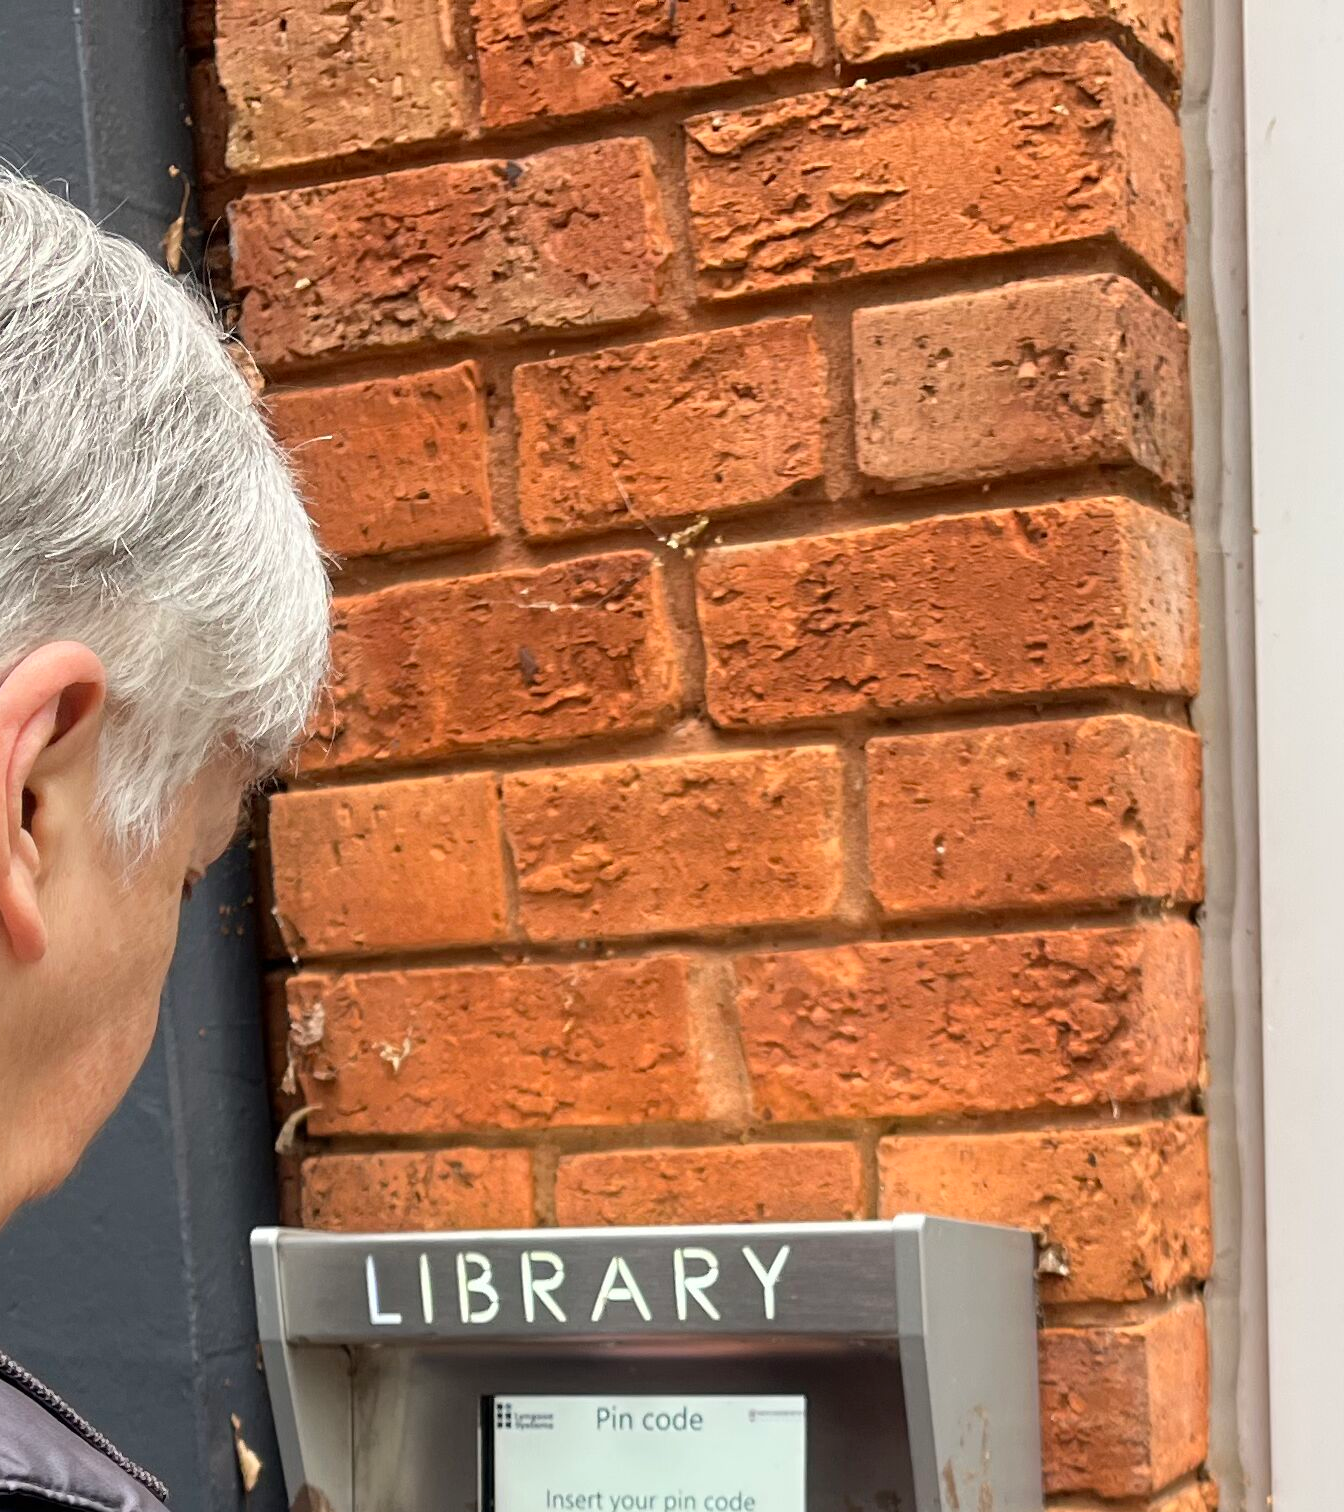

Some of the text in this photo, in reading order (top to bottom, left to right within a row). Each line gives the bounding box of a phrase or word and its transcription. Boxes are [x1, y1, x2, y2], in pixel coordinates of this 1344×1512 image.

[366, 1246, 790, 1324] LIBRARY
[597, 1407, 703, 1431] Pin code
[547, 1490, 602, 1510] Insert
[704, 1491, 755, 1512] code
